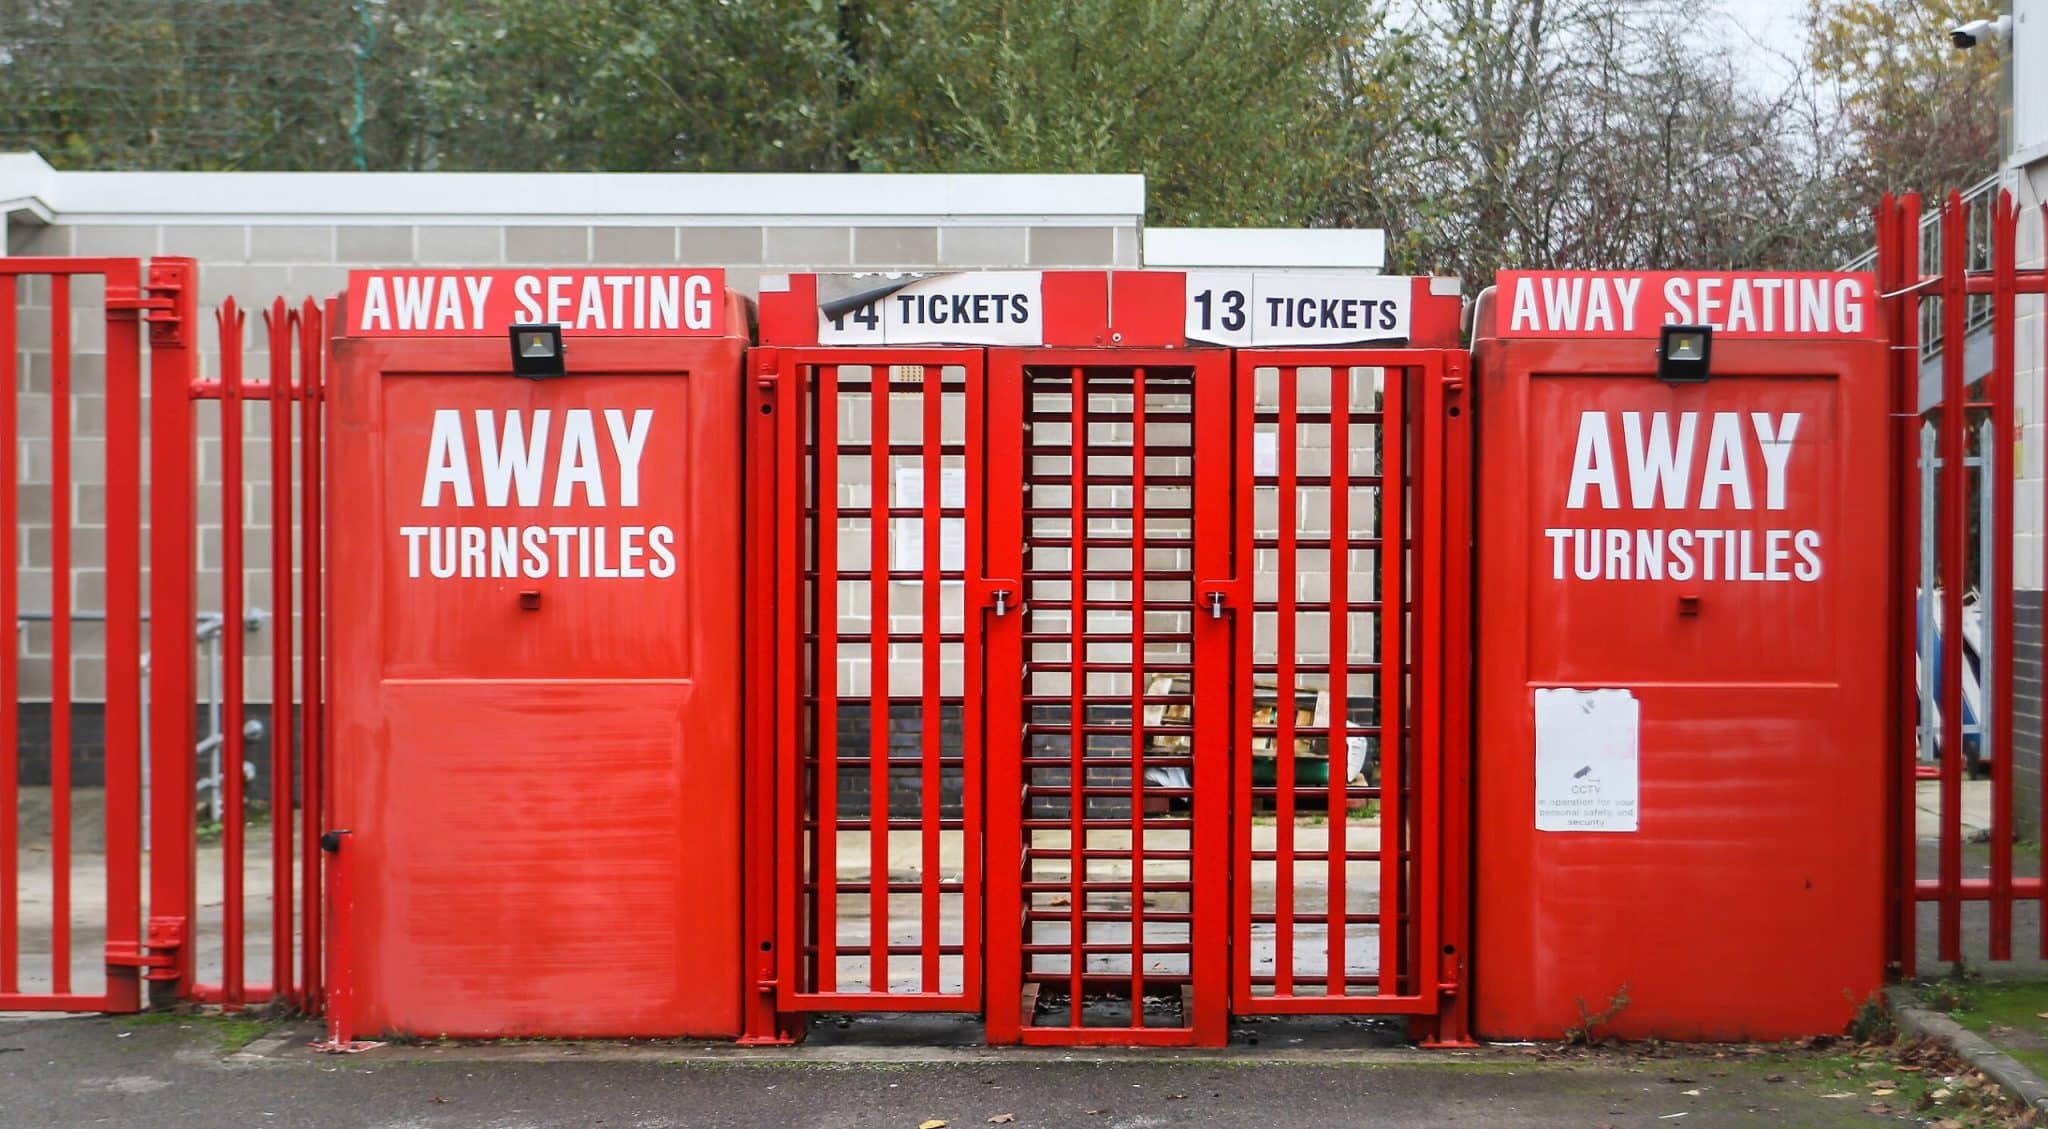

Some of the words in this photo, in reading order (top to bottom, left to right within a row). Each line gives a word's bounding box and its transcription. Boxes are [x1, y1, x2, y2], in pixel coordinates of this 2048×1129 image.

[360, 276, 494, 330] AWAY
[513, 275, 712, 330] SEATING
[897, 294, 1029, 324] TICKETS
[1194, 289, 1246, 331] 13
[1266, 297, 1397, 330] TICKETS
[1510, 277, 1641, 331] AWAY
[1663, 277, 1863, 333] SEATING
[421, 409, 654, 507] AWAY
[1566, 411, 1801, 510] AWAY
[400, 526, 676, 578] TURNSTILES
[1545, 528, 1822, 582] TURNSTILES
[1571, 785, 1600, 794] CCTV
